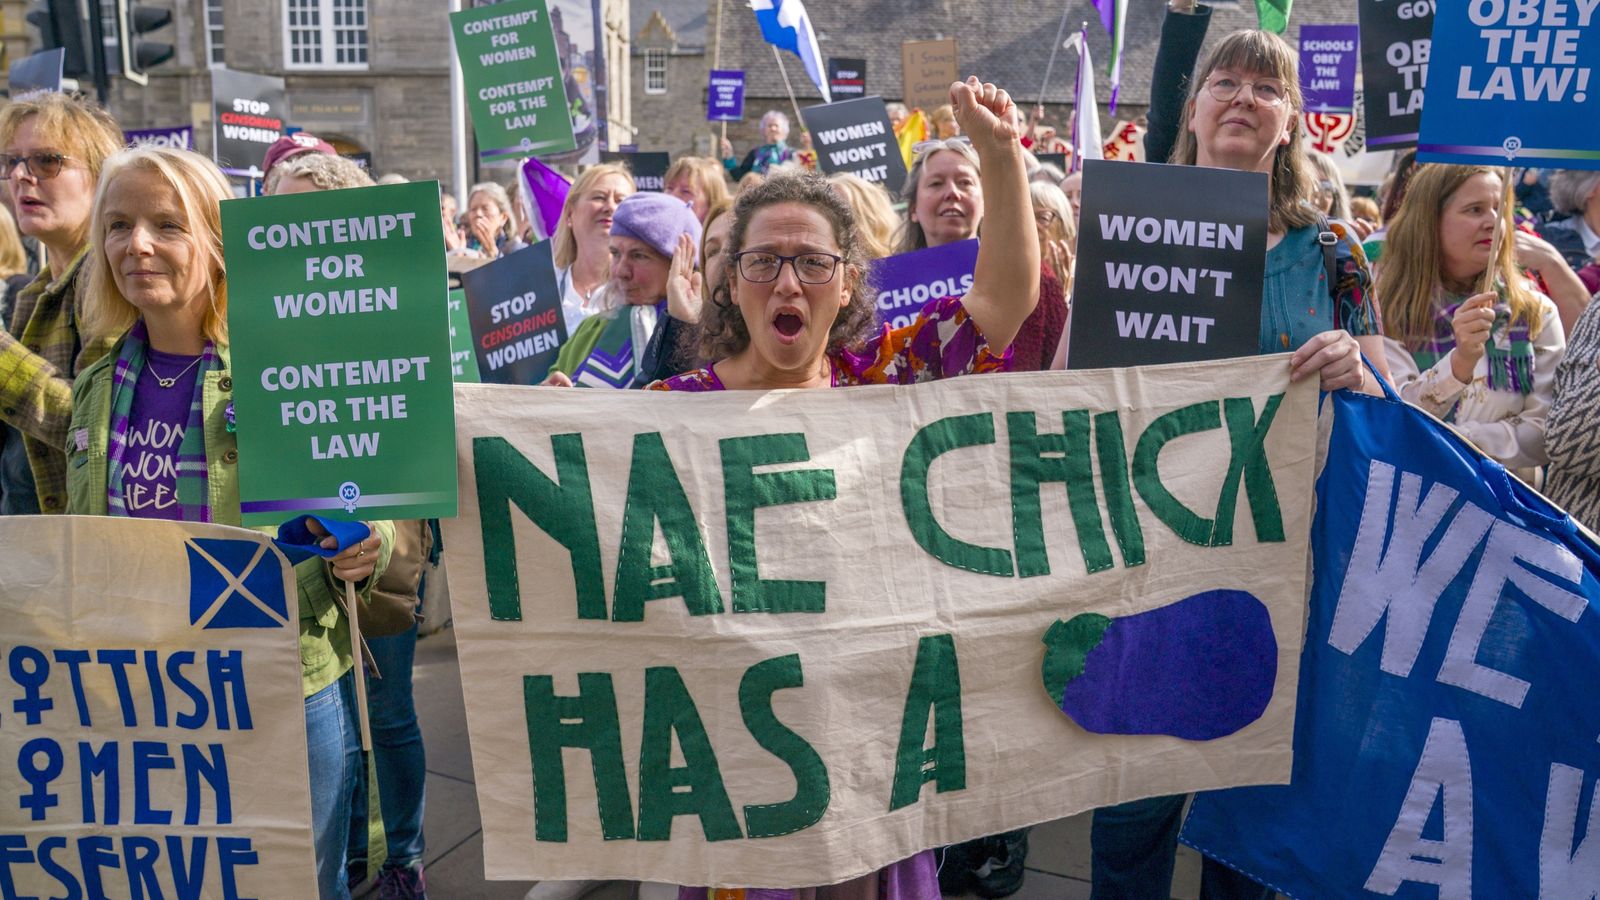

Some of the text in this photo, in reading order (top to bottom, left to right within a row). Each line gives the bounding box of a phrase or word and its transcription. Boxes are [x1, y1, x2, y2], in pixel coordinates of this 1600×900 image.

[463, 10, 538, 35] CONTEMPT
[1468, 0, 1600, 27] OBEY
[491, 31, 519, 48] FOR
[1303, 40, 1354, 52] SCHOOLS
[1386, 39, 1432, 67] OB
[1480, 29, 1581, 65] THE
[479, 46, 537, 67] WOMEN
[1312, 53, 1342, 65] OBEY
[1311, 79, 1340, 91] LAW!
[1315, 66, 1338, 77] THE
[1456, 66, 1592, 103] LAW!
[478, 76, 554, 101] CONTEMPT
[233, 98, 270, 115] STOP
[489, 95, 548, 117] FOR THE
[1388, 89, 1425, 117] LA
[223, 125, 280, 144] WOMEN
[504, 114, 537, 130] LAW
[817, 121, 886, 145] WOMEN
[829, 142, 887, 166] WON'T
[635, 176, 664, 190] MEN
[247, 212, 416, 251] CONTEMPT
[1098, 214, 1244, 251] WOMEN
[305, 254, 365, 282] FOR
[1105, 262, 1233, 298] WON'T
[274, 286, 399, 320] WOMEN
[873, 273, 975, 311] CHOOLS
[490, 291, 536, 324] STOP
[481, 308, 558, 350] CENSORING
[1115, 310, 1215, 345] WAIT
[486, 328, 560, 371] WOMEN
[261, 356, 431, 392] CONTEMPT
[280, 394, 408, 427] FOR THE
[309, 432, 381, 461] LAW
[472, 432, 838, 622] NAE
[1328, 459, 1589, 709] WE
[0, 645, 254, 731] OTTISH
[523, 633, 967, 843] HAS A
[1363, 716, 1474, 900] A
